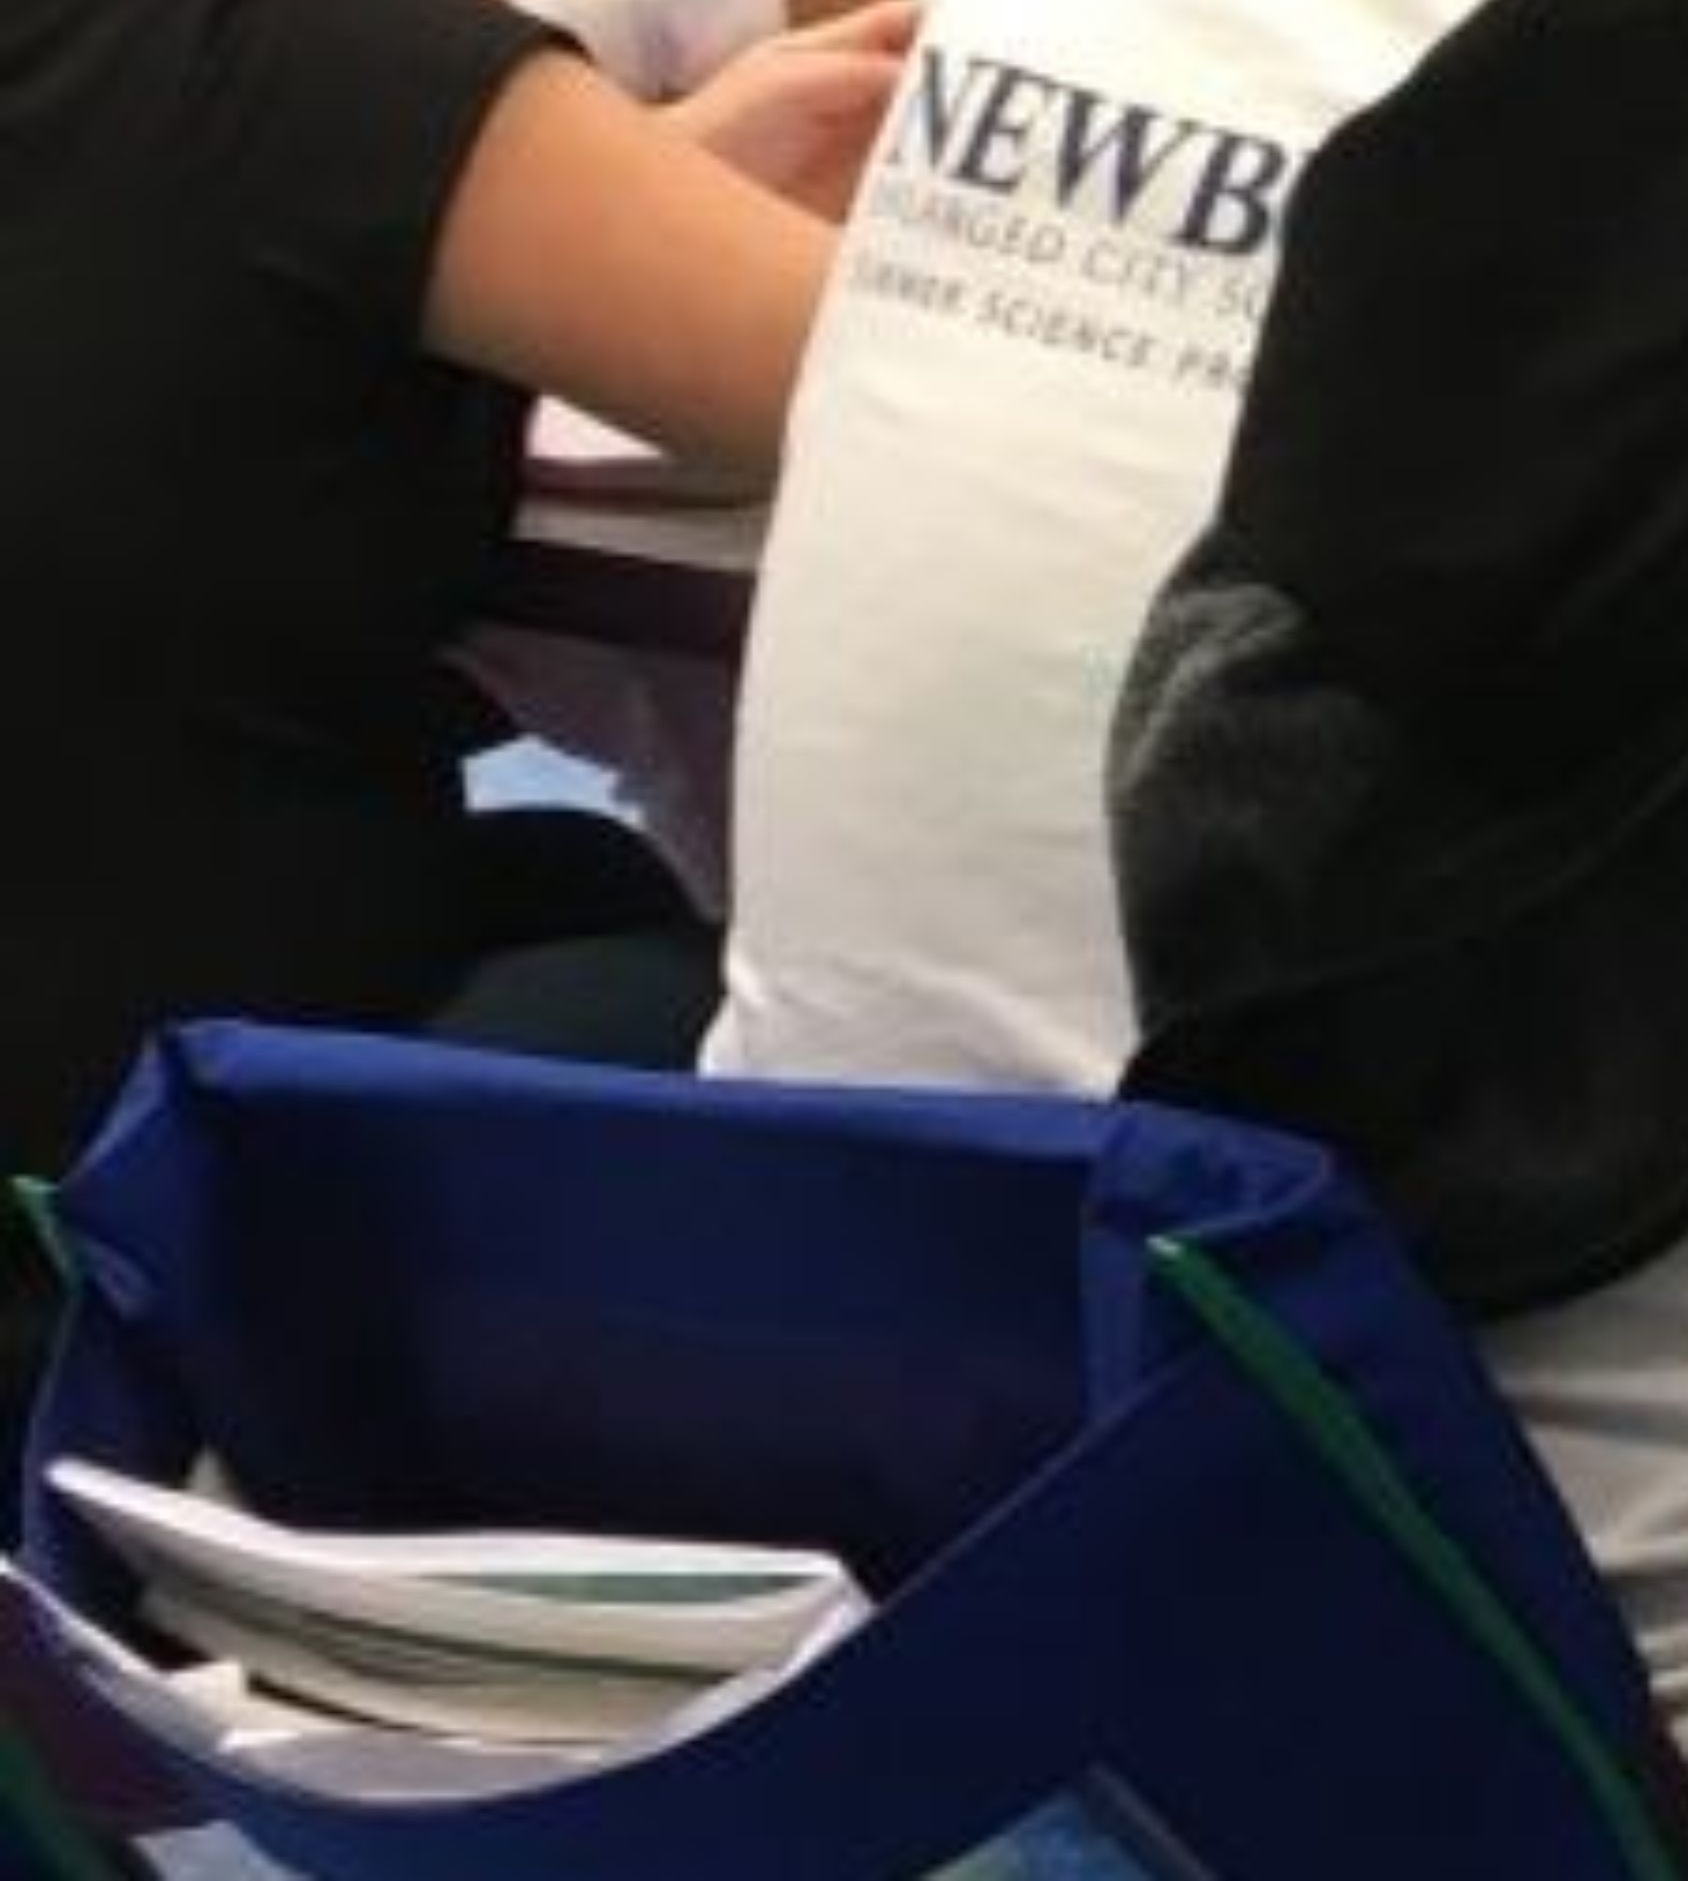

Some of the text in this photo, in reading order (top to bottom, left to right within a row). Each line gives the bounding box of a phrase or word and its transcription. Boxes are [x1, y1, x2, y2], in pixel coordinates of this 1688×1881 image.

[886, 45, 1290, 257] NEWB
[1080, 236, 1198, 311] CITY
[1166, 345, 1252, 393] PR
